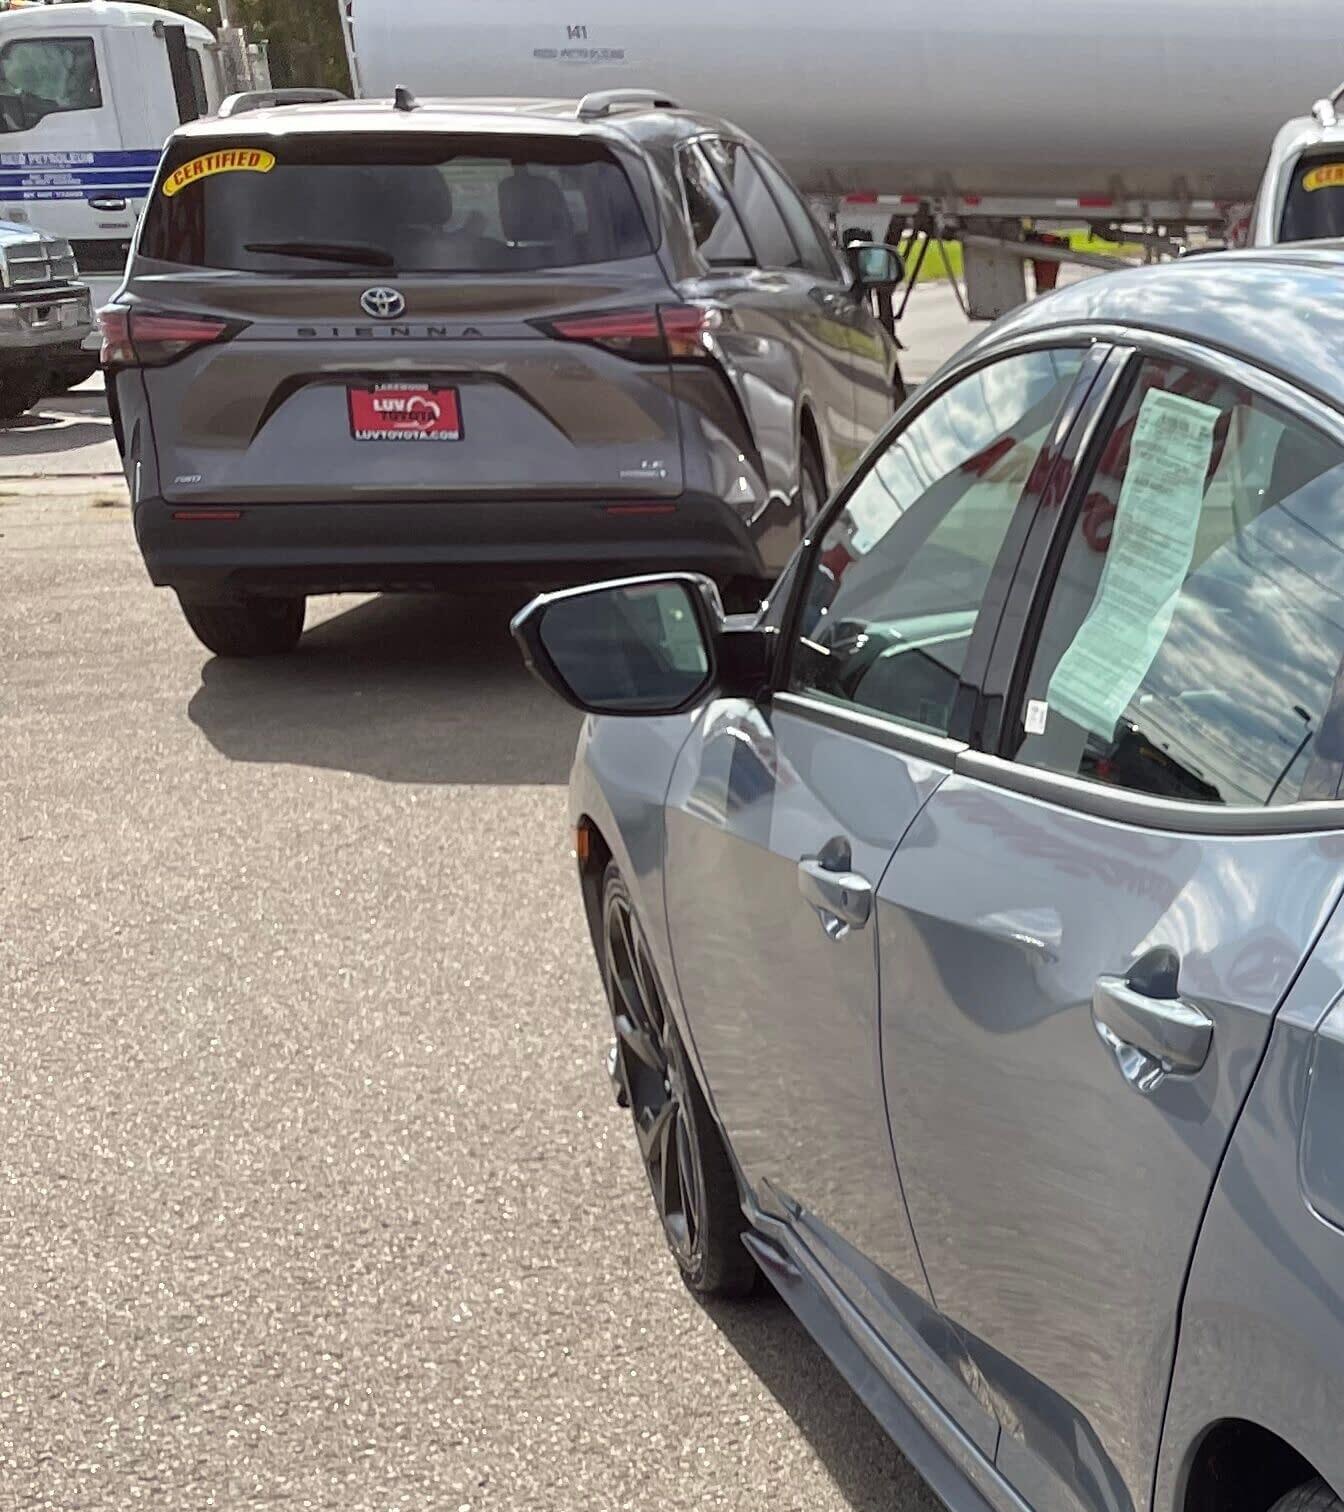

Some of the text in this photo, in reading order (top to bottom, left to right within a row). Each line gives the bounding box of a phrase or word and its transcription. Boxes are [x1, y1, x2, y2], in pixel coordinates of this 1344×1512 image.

[173, 151, 261, 186] CERTIFIED
[297, 327, 483, 337] SIENNA
[373, 398, 406, 412] LUV
